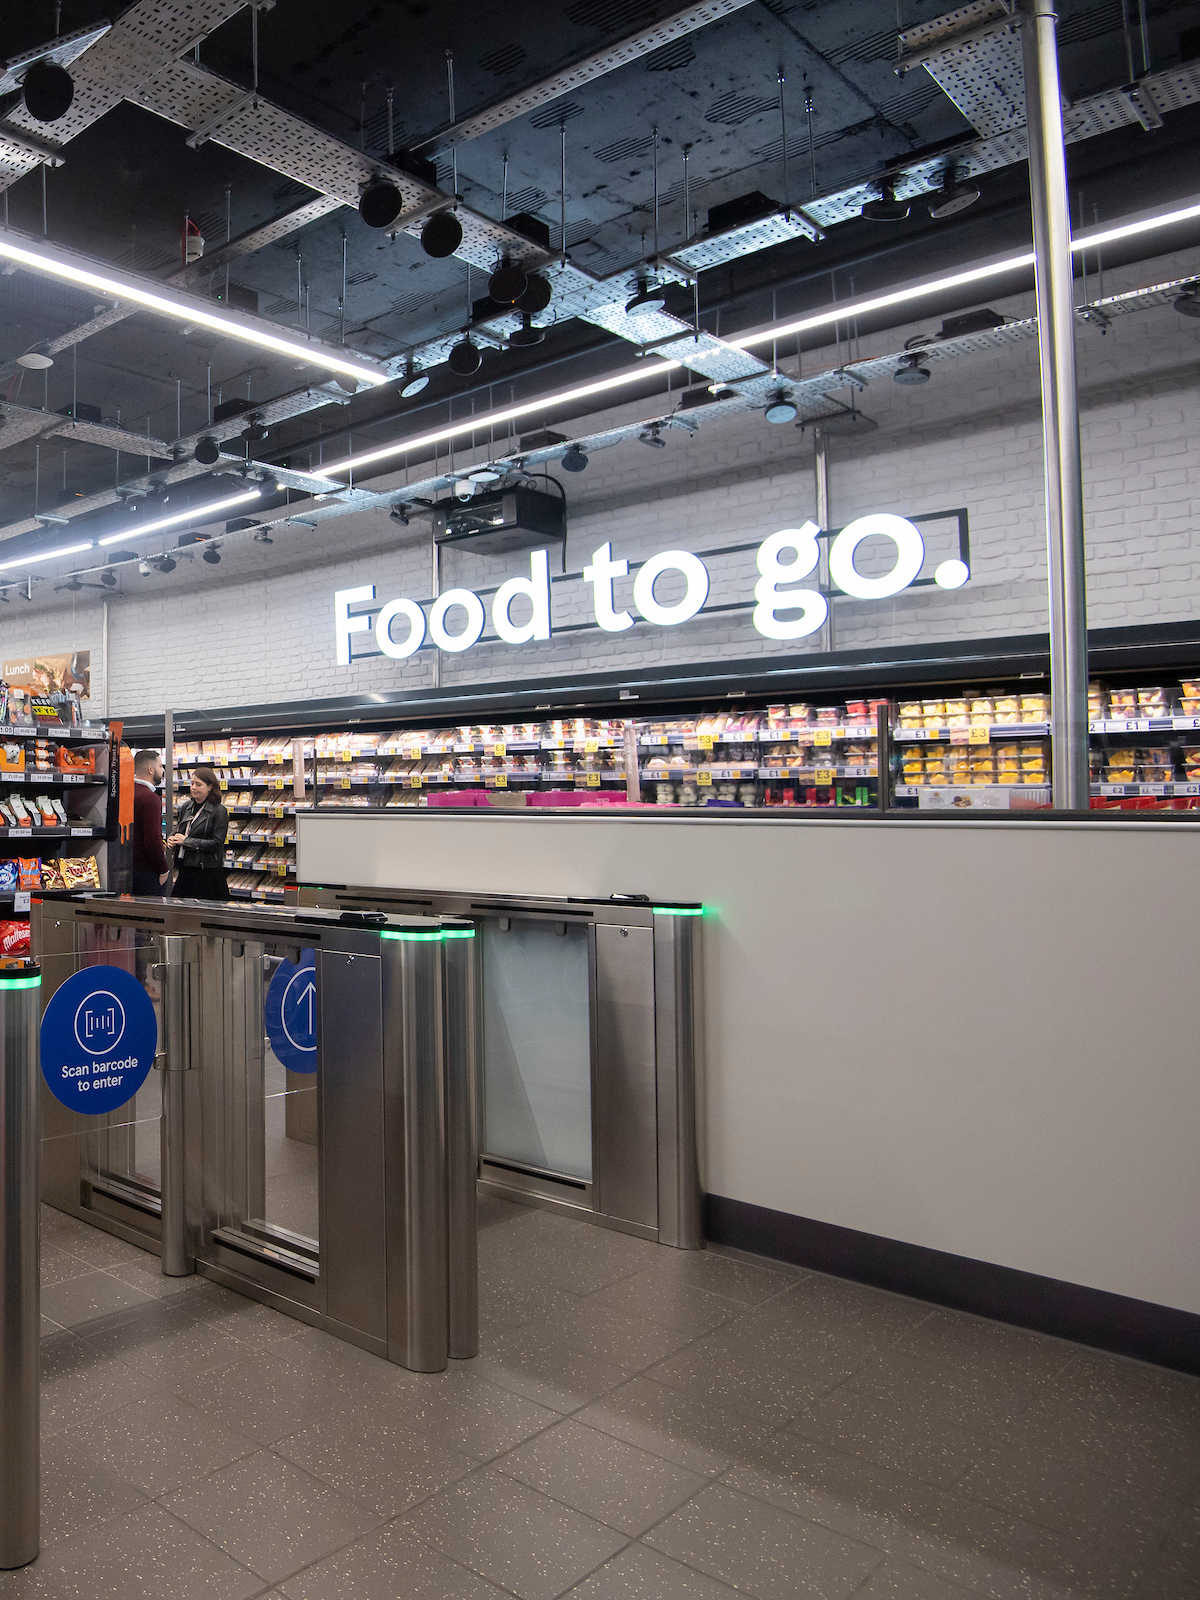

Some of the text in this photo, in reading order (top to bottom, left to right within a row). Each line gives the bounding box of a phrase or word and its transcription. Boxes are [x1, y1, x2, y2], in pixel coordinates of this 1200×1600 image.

[334, 549, 552, 666] Food
[583, 541, 710, 632] to
[5, 662, 30, 676] Lunch
[1126, 722, 1139, 730] £1
[769, 731, 780, 739] £1
[816, 730, 830, 740] £3
[971, 728, 987, 738] £3
[587, 740, 598, 748] £3
[699, 734, 712, 744] £3
[495, 744, 504, 752] £3
[698, 770, 710, 780] £3
[721, 770, 731, 778] £1
[769, 770, 779, 778] £1
[816, 770, 830, 780] £3
[856, 768, 867, 776] £1
[496, 774, 506, 782] £3
[588, 773, 598, 782] £3
[3, 930, 30, 951] Maltese
[61, 1056, 138, 1078] Scan barcode
[77, 1075, 124, 1092] to enter
